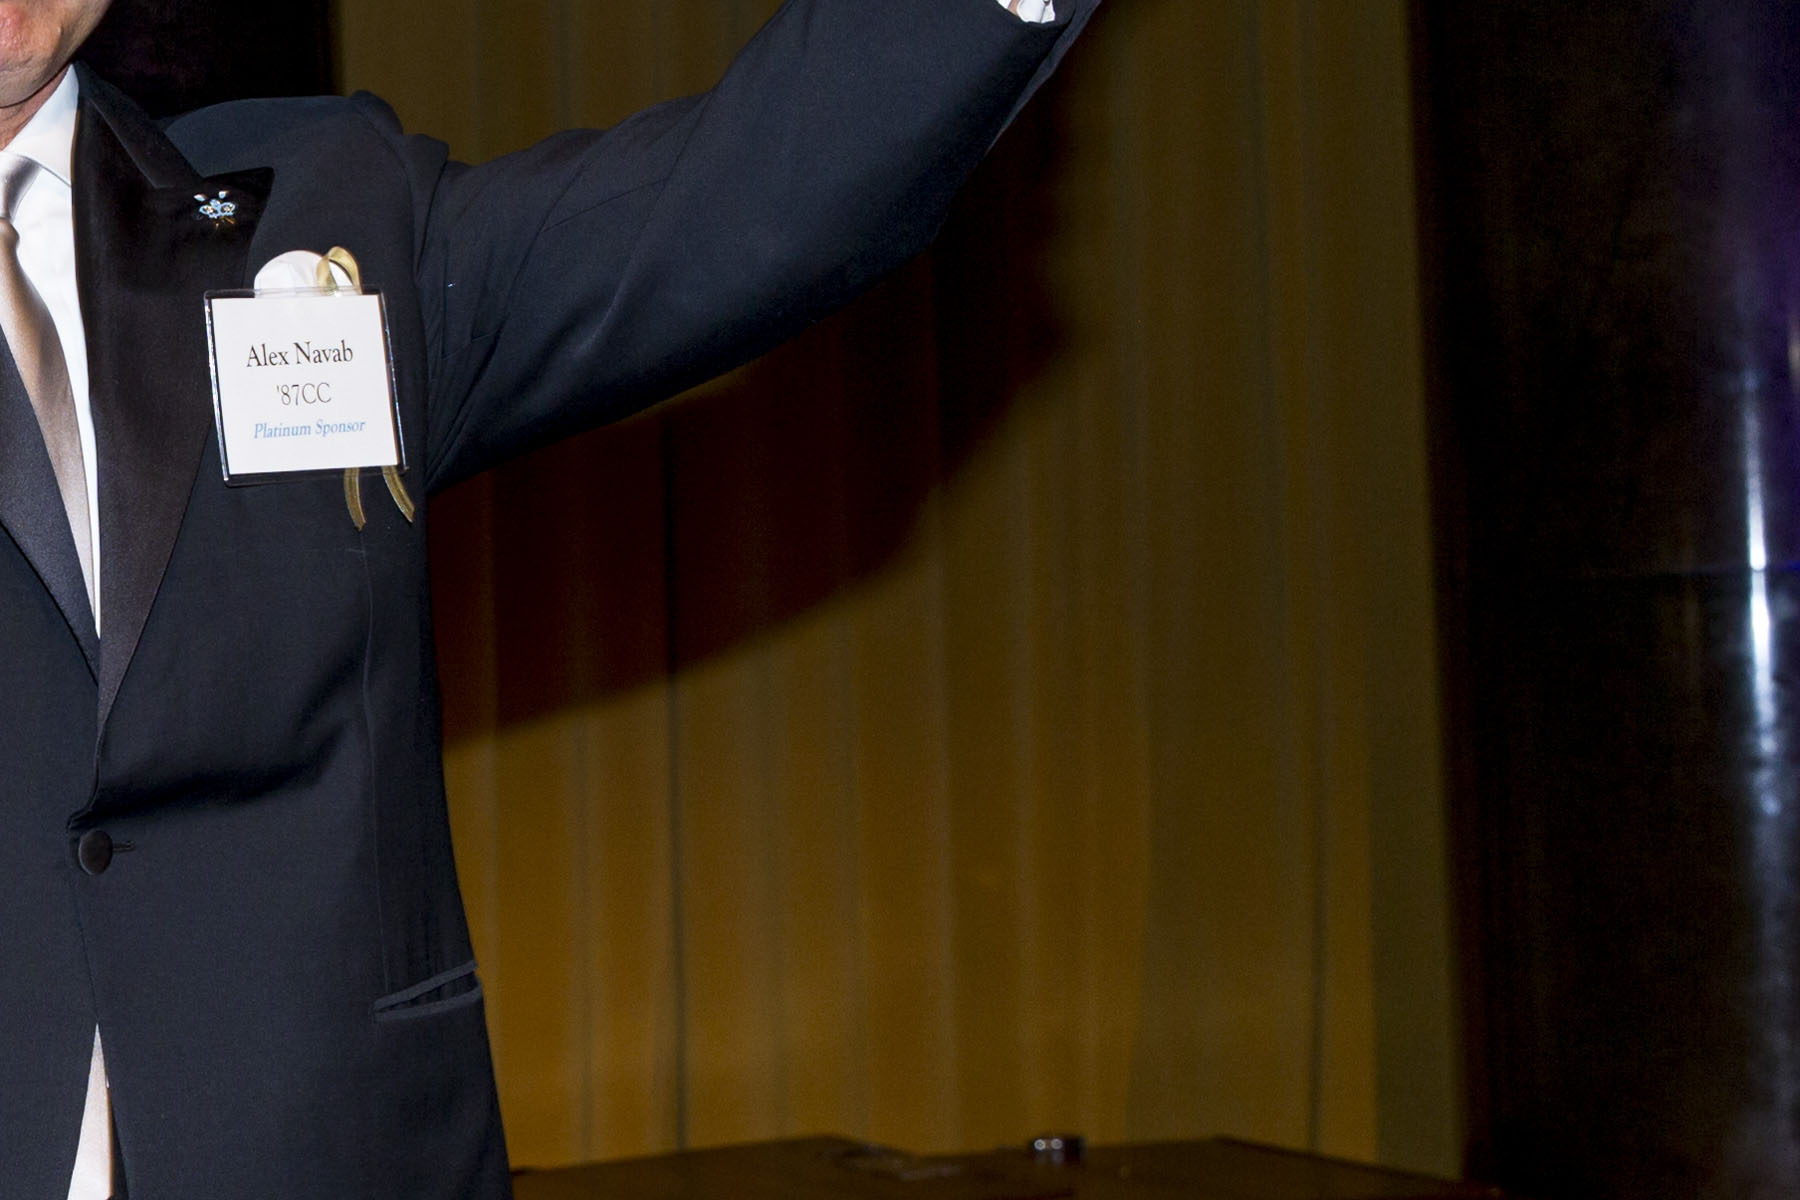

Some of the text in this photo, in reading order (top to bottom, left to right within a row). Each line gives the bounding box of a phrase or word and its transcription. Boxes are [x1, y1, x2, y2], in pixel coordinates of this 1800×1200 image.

[246, 339, 353, 367] Alex Navab
[253, 418, 366, 439] Platinum Sponsor
